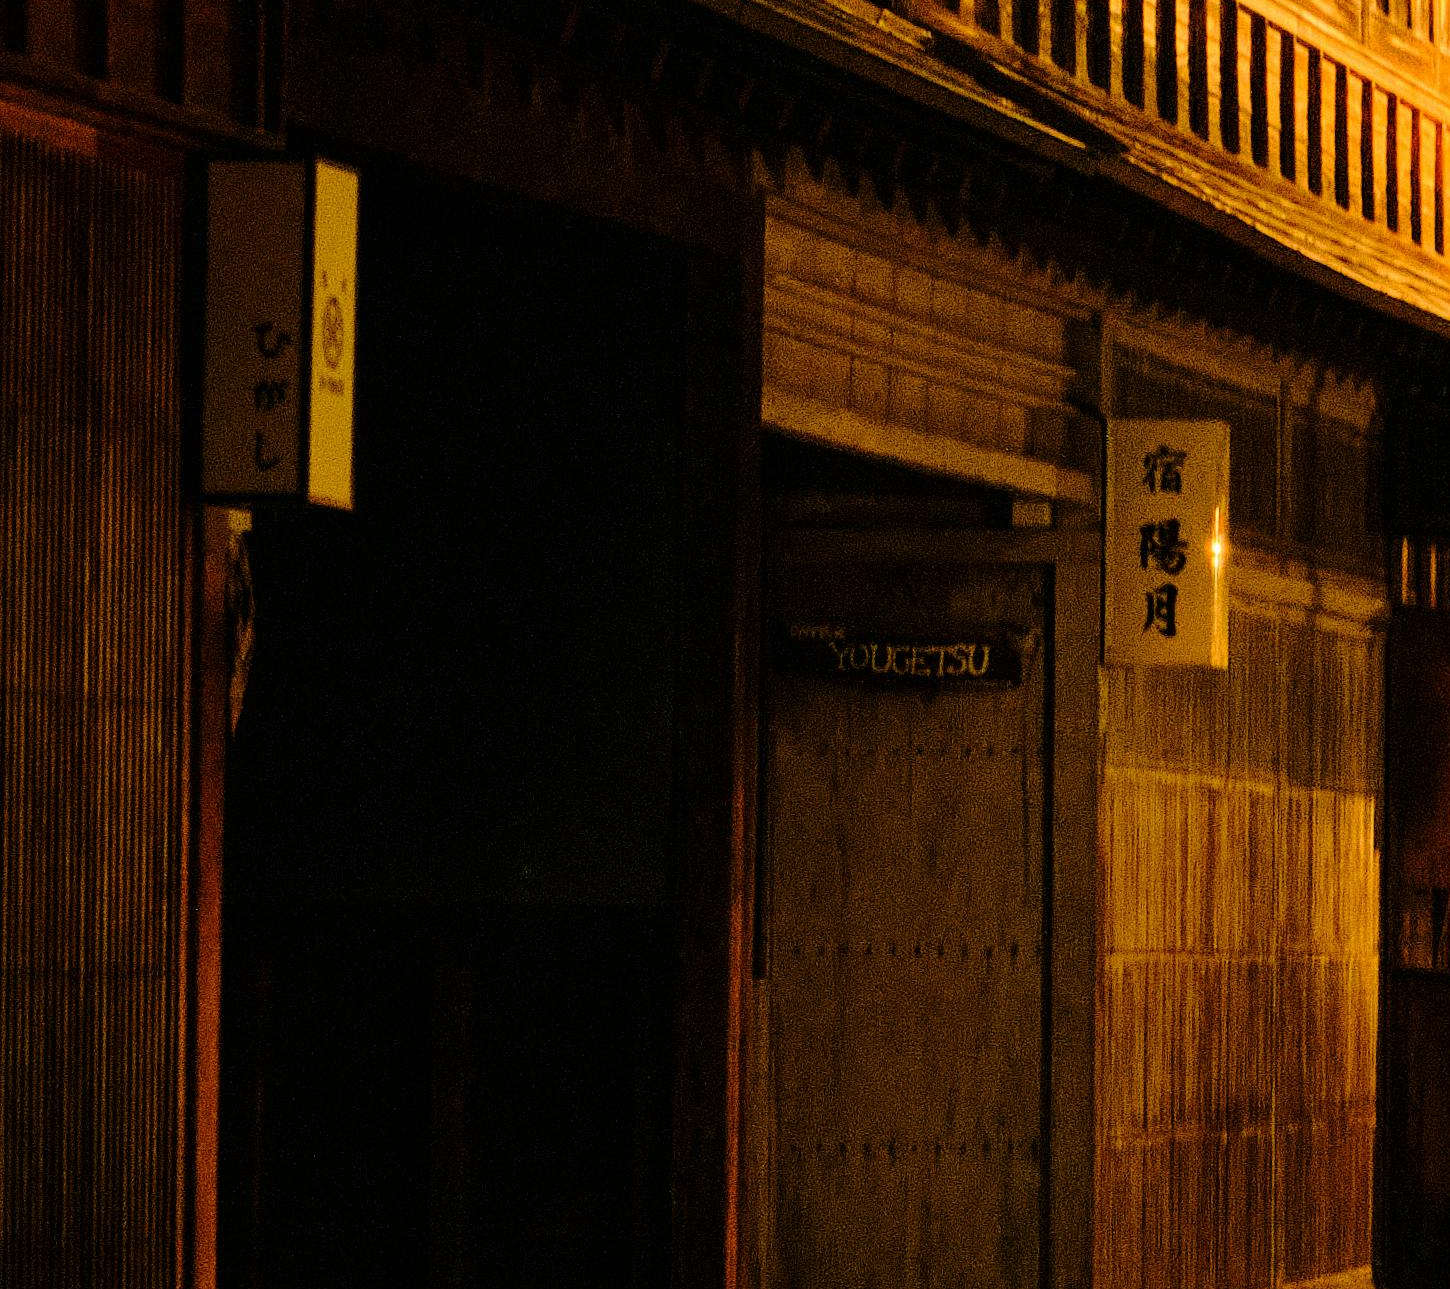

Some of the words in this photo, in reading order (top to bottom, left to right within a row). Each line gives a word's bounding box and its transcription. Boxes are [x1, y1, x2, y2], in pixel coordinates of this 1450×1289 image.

[1139, 444, 1187, 637] 宿陽月
[828, 641, 992, 679] YOUGETSU
